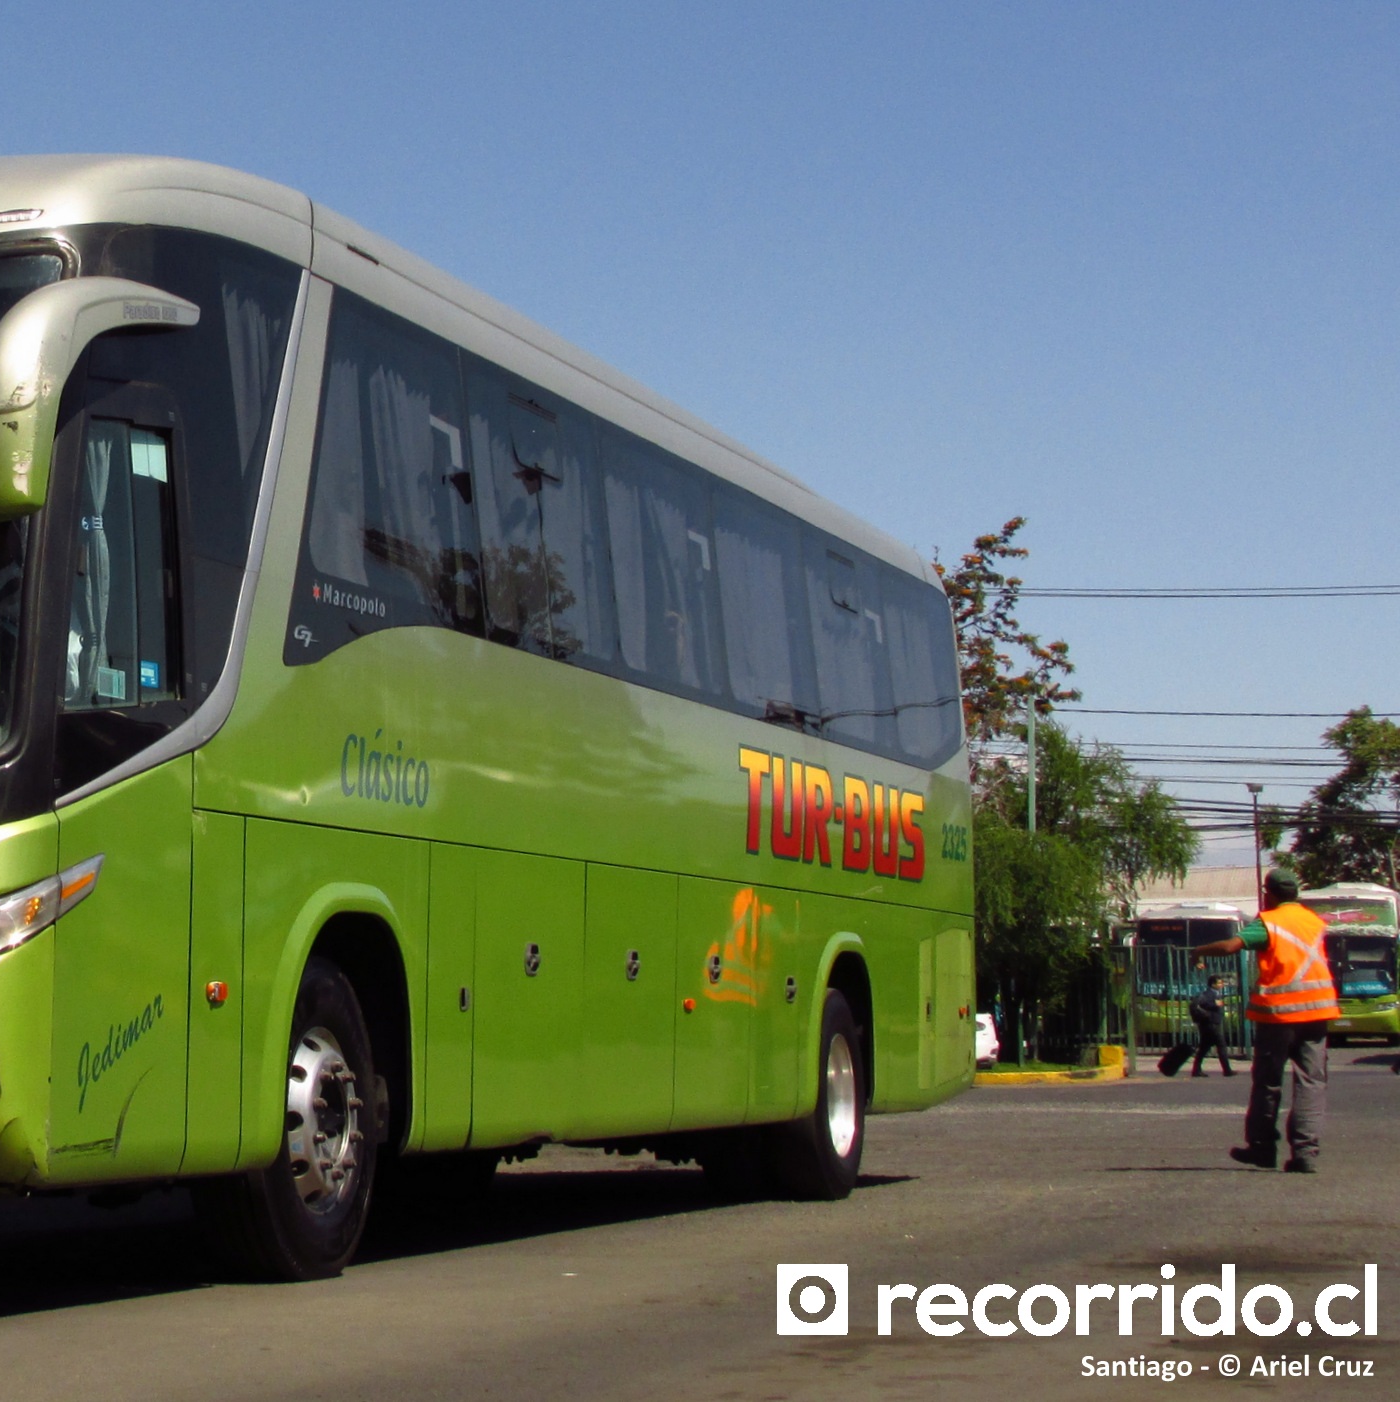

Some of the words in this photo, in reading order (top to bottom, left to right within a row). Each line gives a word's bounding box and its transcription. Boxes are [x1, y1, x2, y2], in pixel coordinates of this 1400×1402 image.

[323, 583, 386, 617] Marcopolo
[341, 728, 429, 808] Clásico
[941, 822, 967, 862] 2325
[77, 993, 165, 1114] Jedimar
